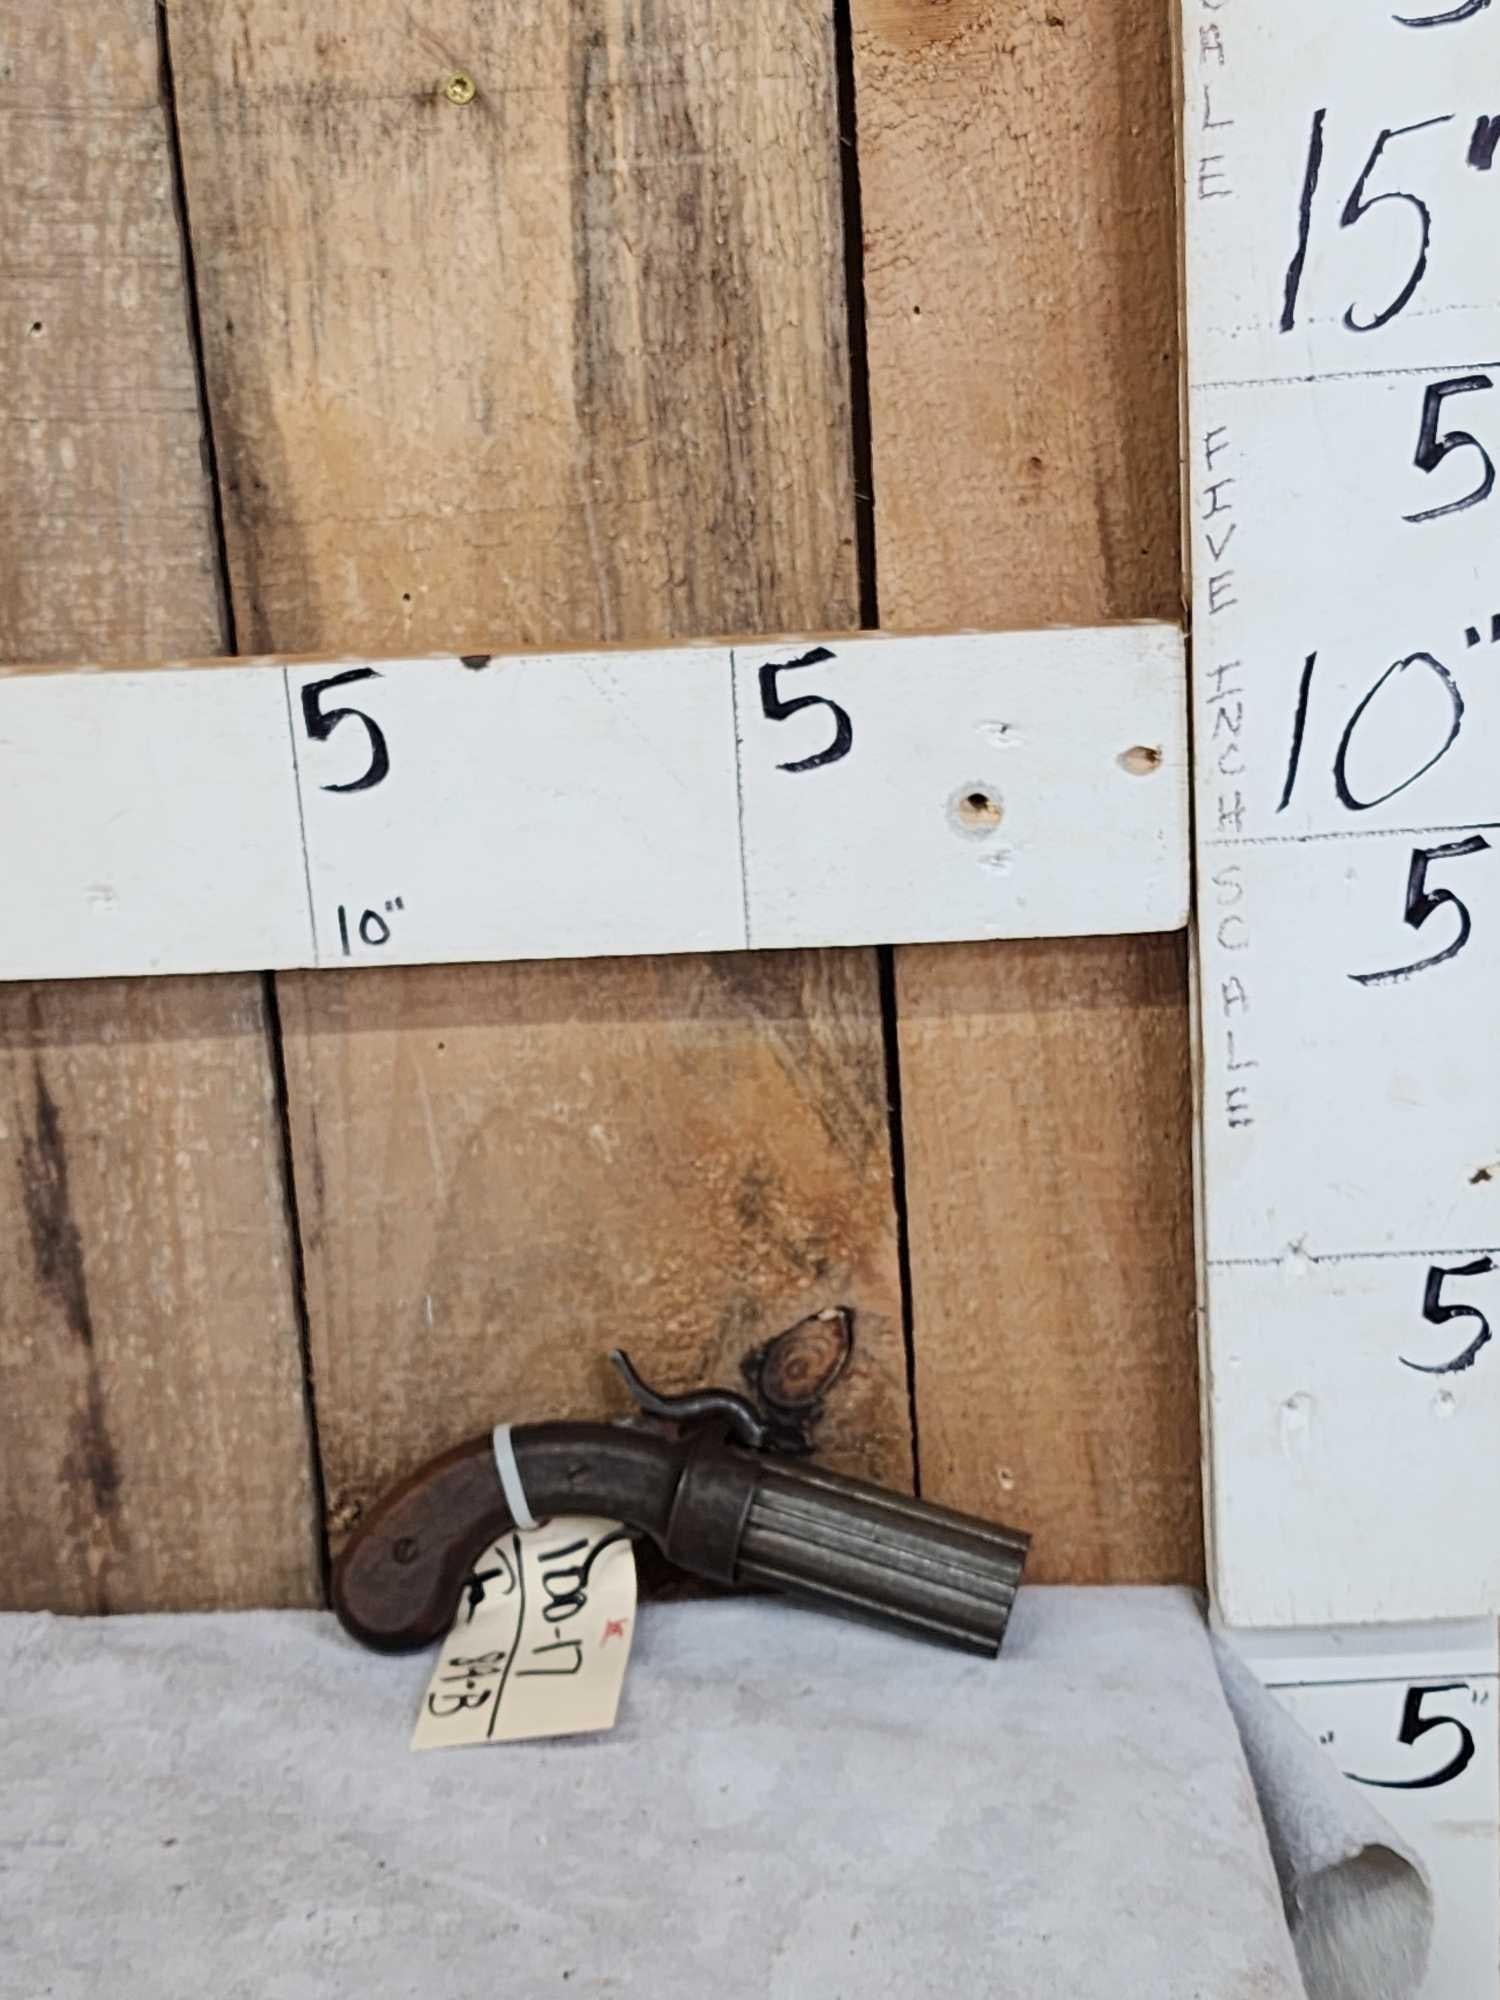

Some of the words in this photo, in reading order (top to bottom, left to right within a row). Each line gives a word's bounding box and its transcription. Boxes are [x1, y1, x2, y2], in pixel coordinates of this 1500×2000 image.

[1280, 107, 1500, 333] 15"
[1202, 426, 1238, 616] FIVE
[1401, 374, 1495, 522] 5
[301, 667, 390, 793] 5
[758, 646, 854, 773] 5
[1205, 660, 1245, 833] INCH
[1276, 613, 1500, 818] 10"
[337, 896, 405, 957] 10"
[1347, 835, 1492, 986] 5
[1212, 865, 1259, 1129] SCALE
[1399, 1256, 1498, 1374] 5
[516, 1538, 590, 1675] 100-17
